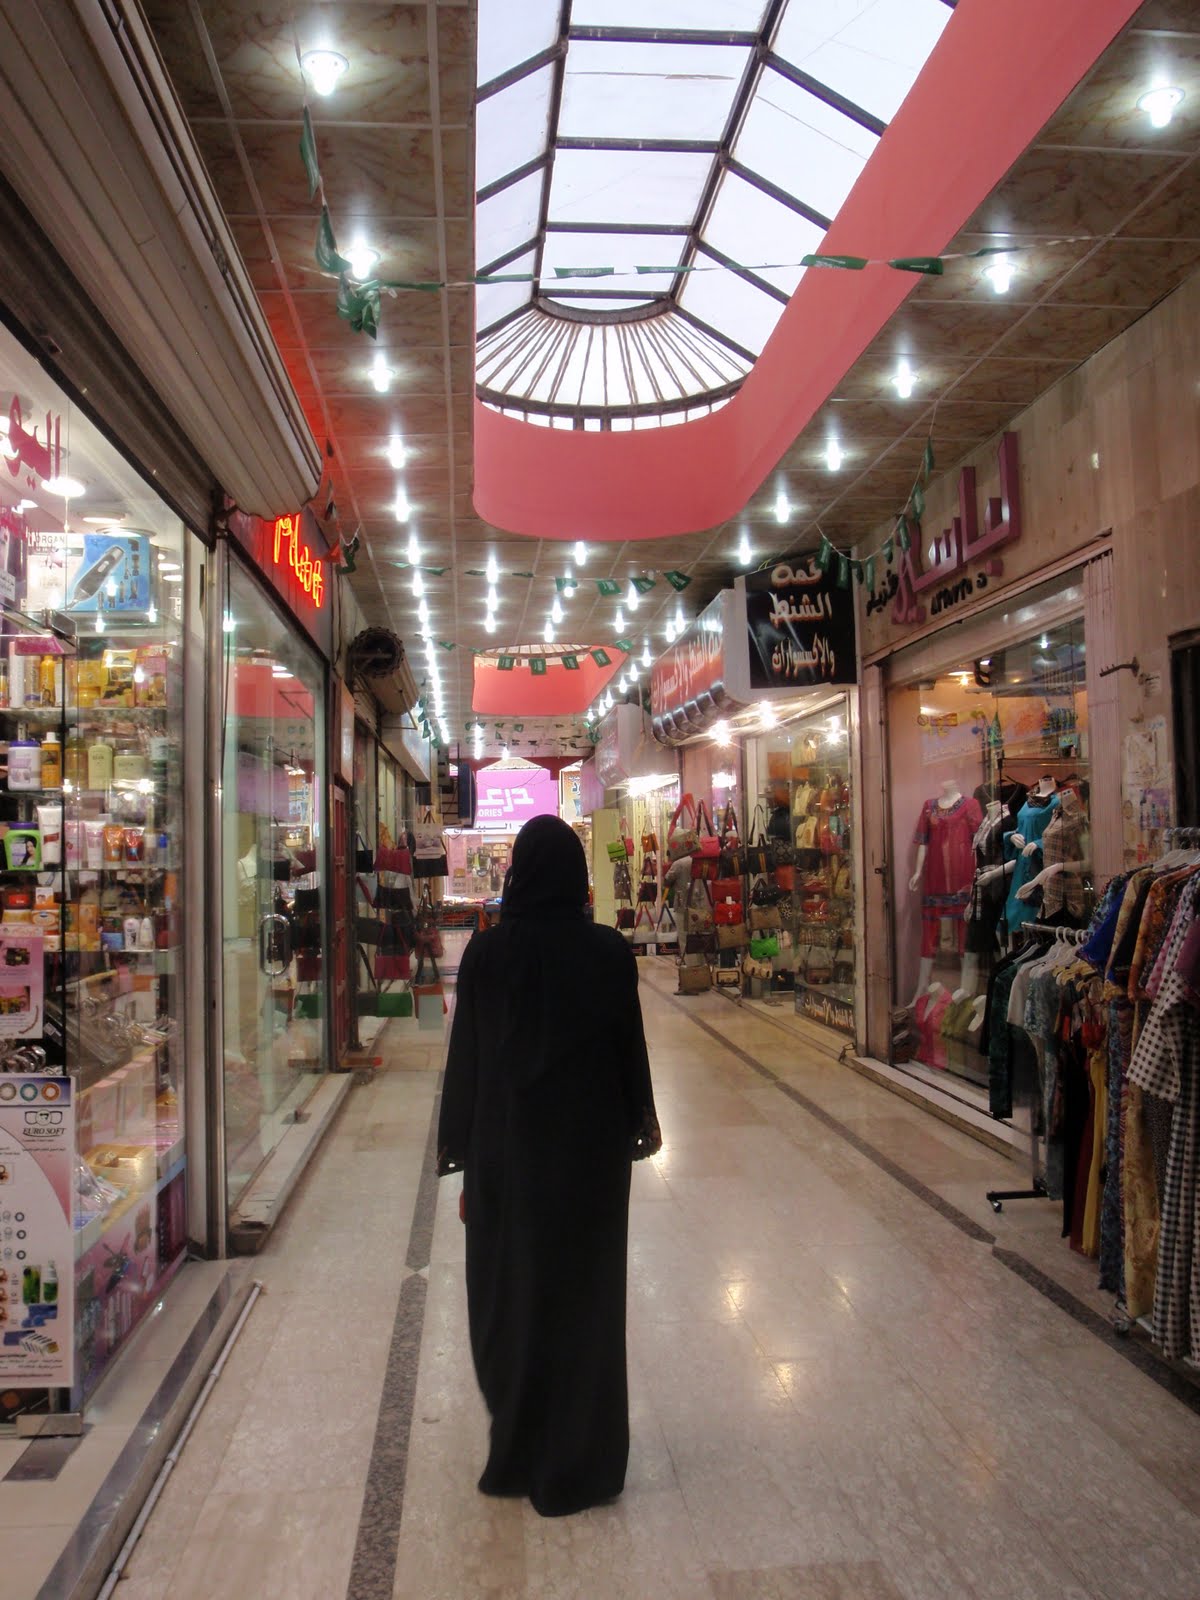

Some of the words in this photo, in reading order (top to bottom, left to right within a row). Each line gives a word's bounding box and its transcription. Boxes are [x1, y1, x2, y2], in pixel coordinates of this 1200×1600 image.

[767, 590, 834, 629] الشنط
[23, 1127, 45, 1135] EURO
[45, 1127, 66, 1135] SOFT
